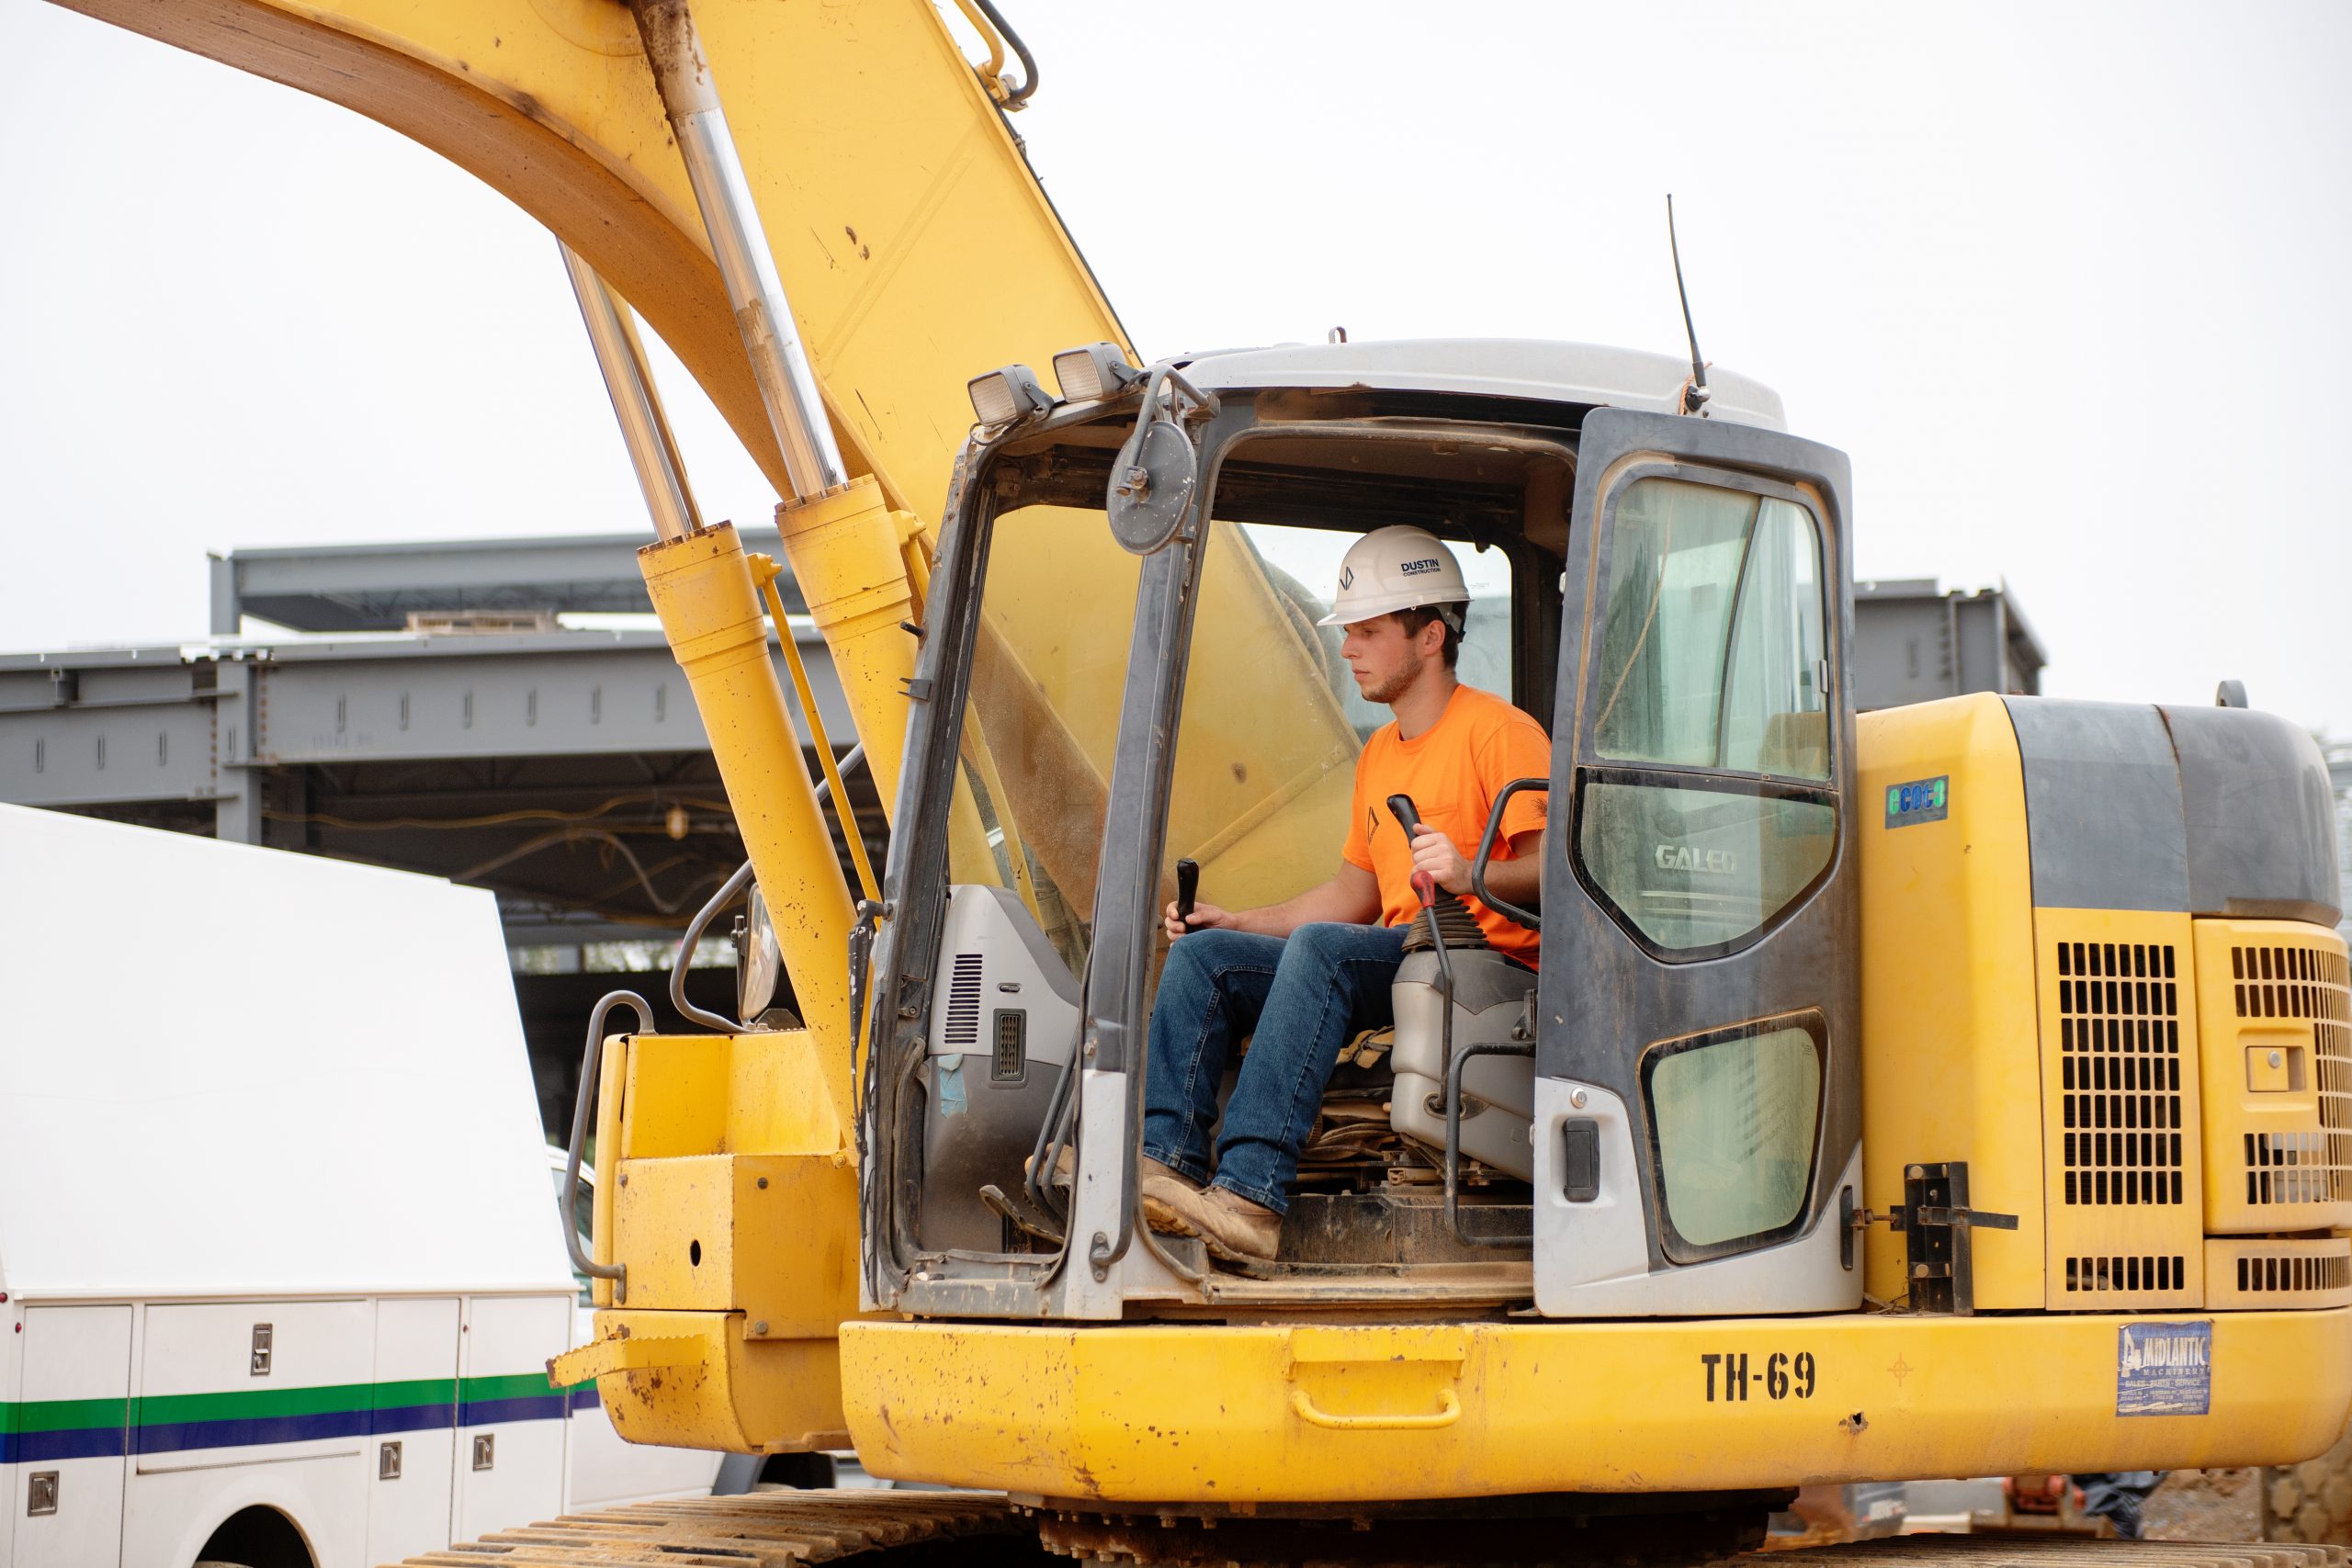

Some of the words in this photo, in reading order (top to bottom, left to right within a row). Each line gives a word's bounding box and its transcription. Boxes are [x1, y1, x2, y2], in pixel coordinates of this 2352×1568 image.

[1401, 558, 1439, 571] DUSTIN
[1403, 568, 1441, 577] CONSTRUCTION
[1655, 844, 1736, 874] GALEO
[2143, 1337, 2206, 1367] MIDLANTIC
[1702, 1351, 1815, 1402] TH-69
[2143, 1368, 2207, 1376] MACHINERY
[2150, 1379, 2170, 1387] PARTS
